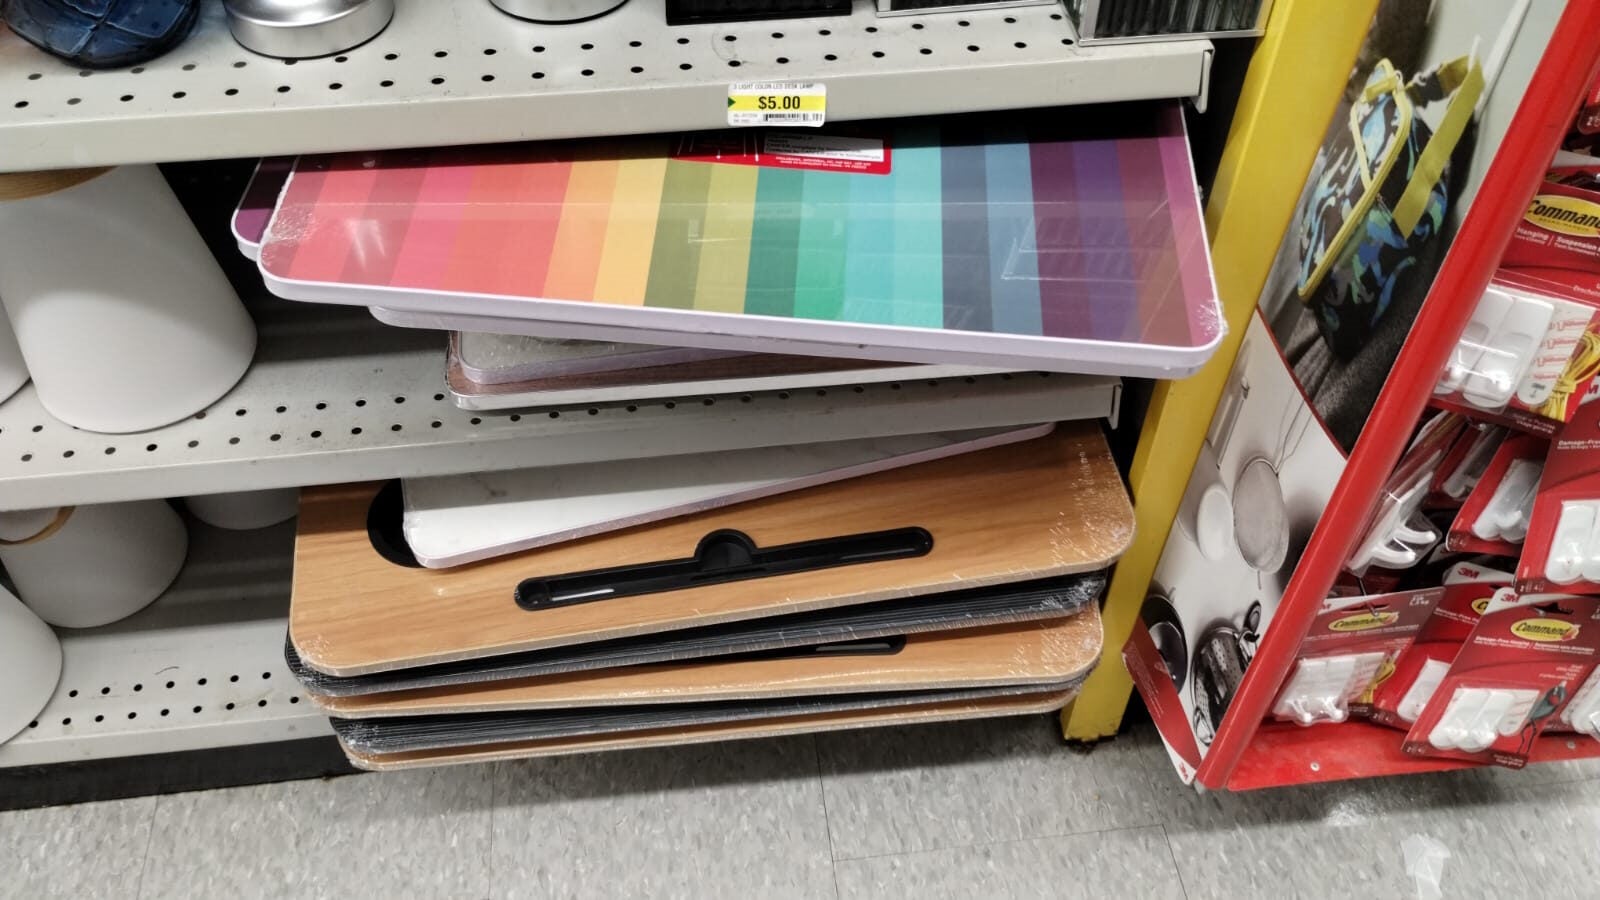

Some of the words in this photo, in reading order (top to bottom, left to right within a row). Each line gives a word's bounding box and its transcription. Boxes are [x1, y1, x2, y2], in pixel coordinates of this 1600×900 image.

[758, 95, 801, 110] $5.00
[1458, 568, 1479, 579] 3M
[1501, 593, 1519, 603] 3M
[1515, 622, 1571, 635] Command
